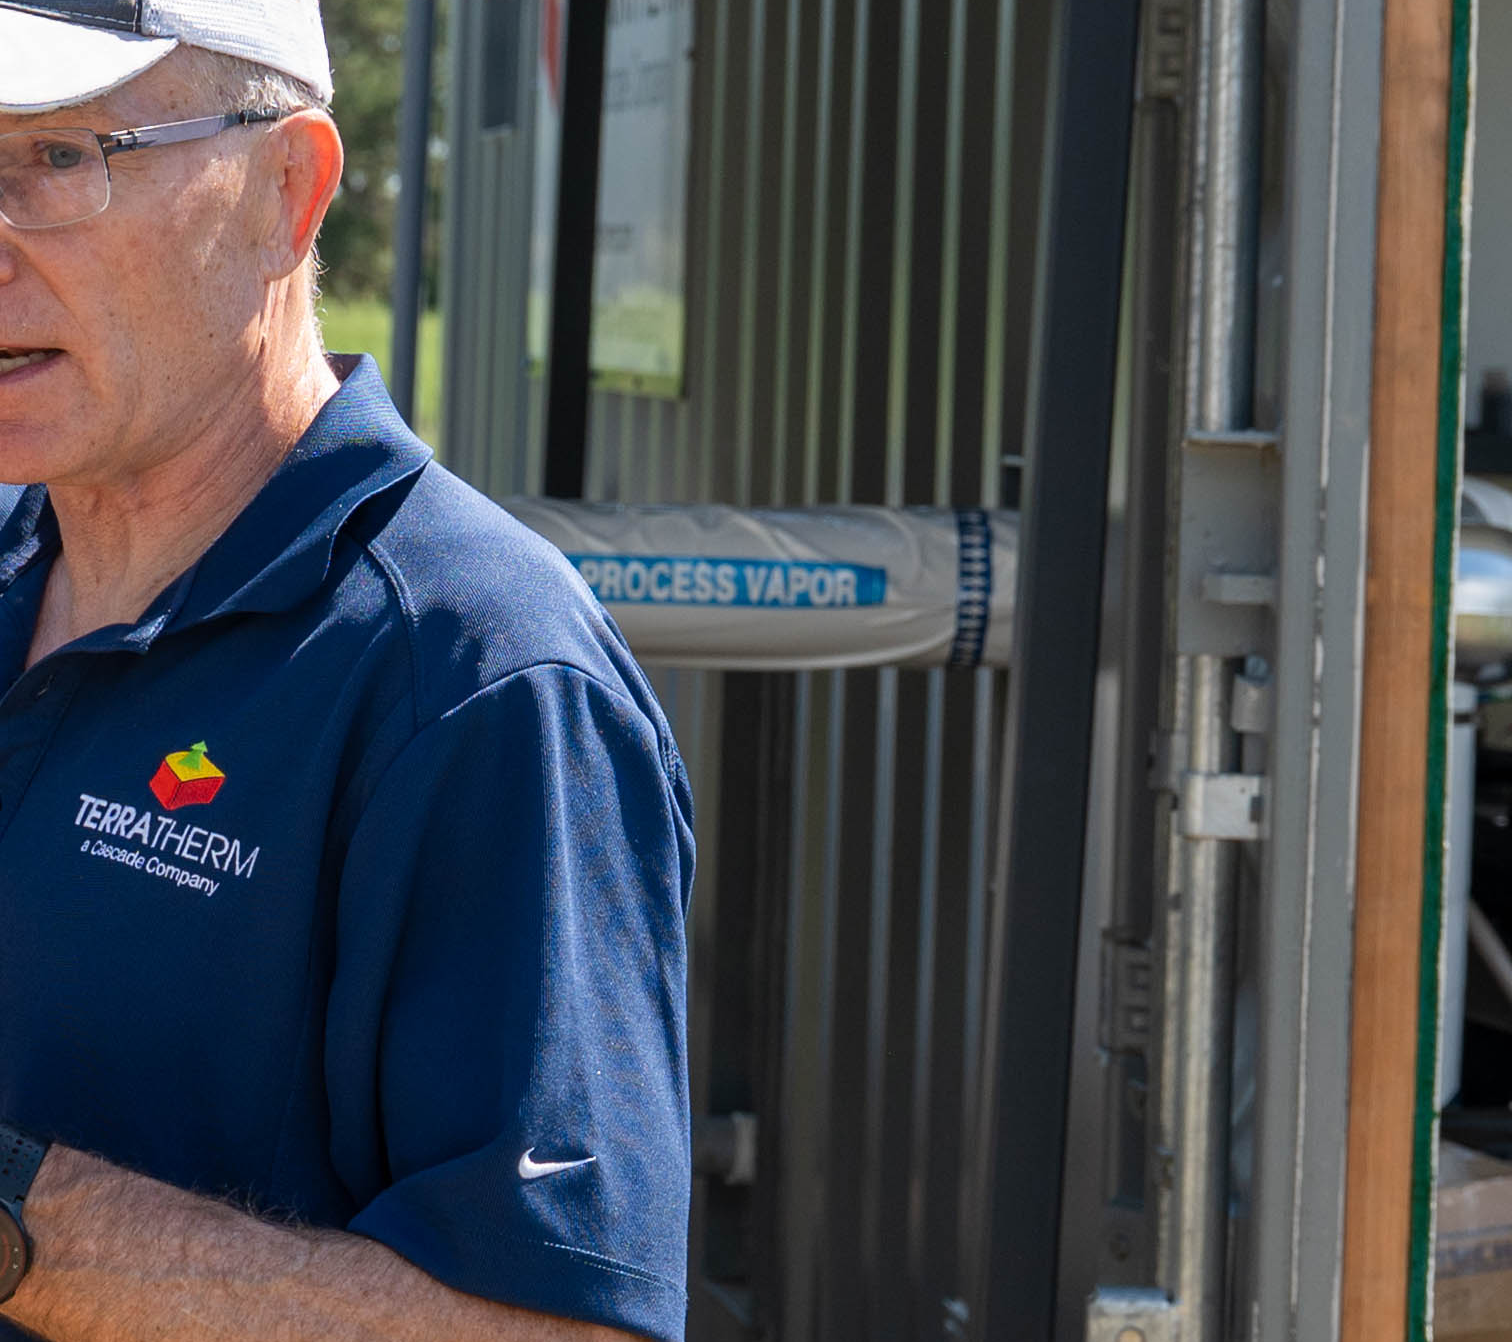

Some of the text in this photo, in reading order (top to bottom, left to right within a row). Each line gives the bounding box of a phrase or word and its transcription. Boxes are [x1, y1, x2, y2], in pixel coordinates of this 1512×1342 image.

[578, 559, 858, 606] PROCESS VAPOR
[73, 793, 261, 880] TERRATHERM
[79, 838, 220, 898] a Cascade Company
